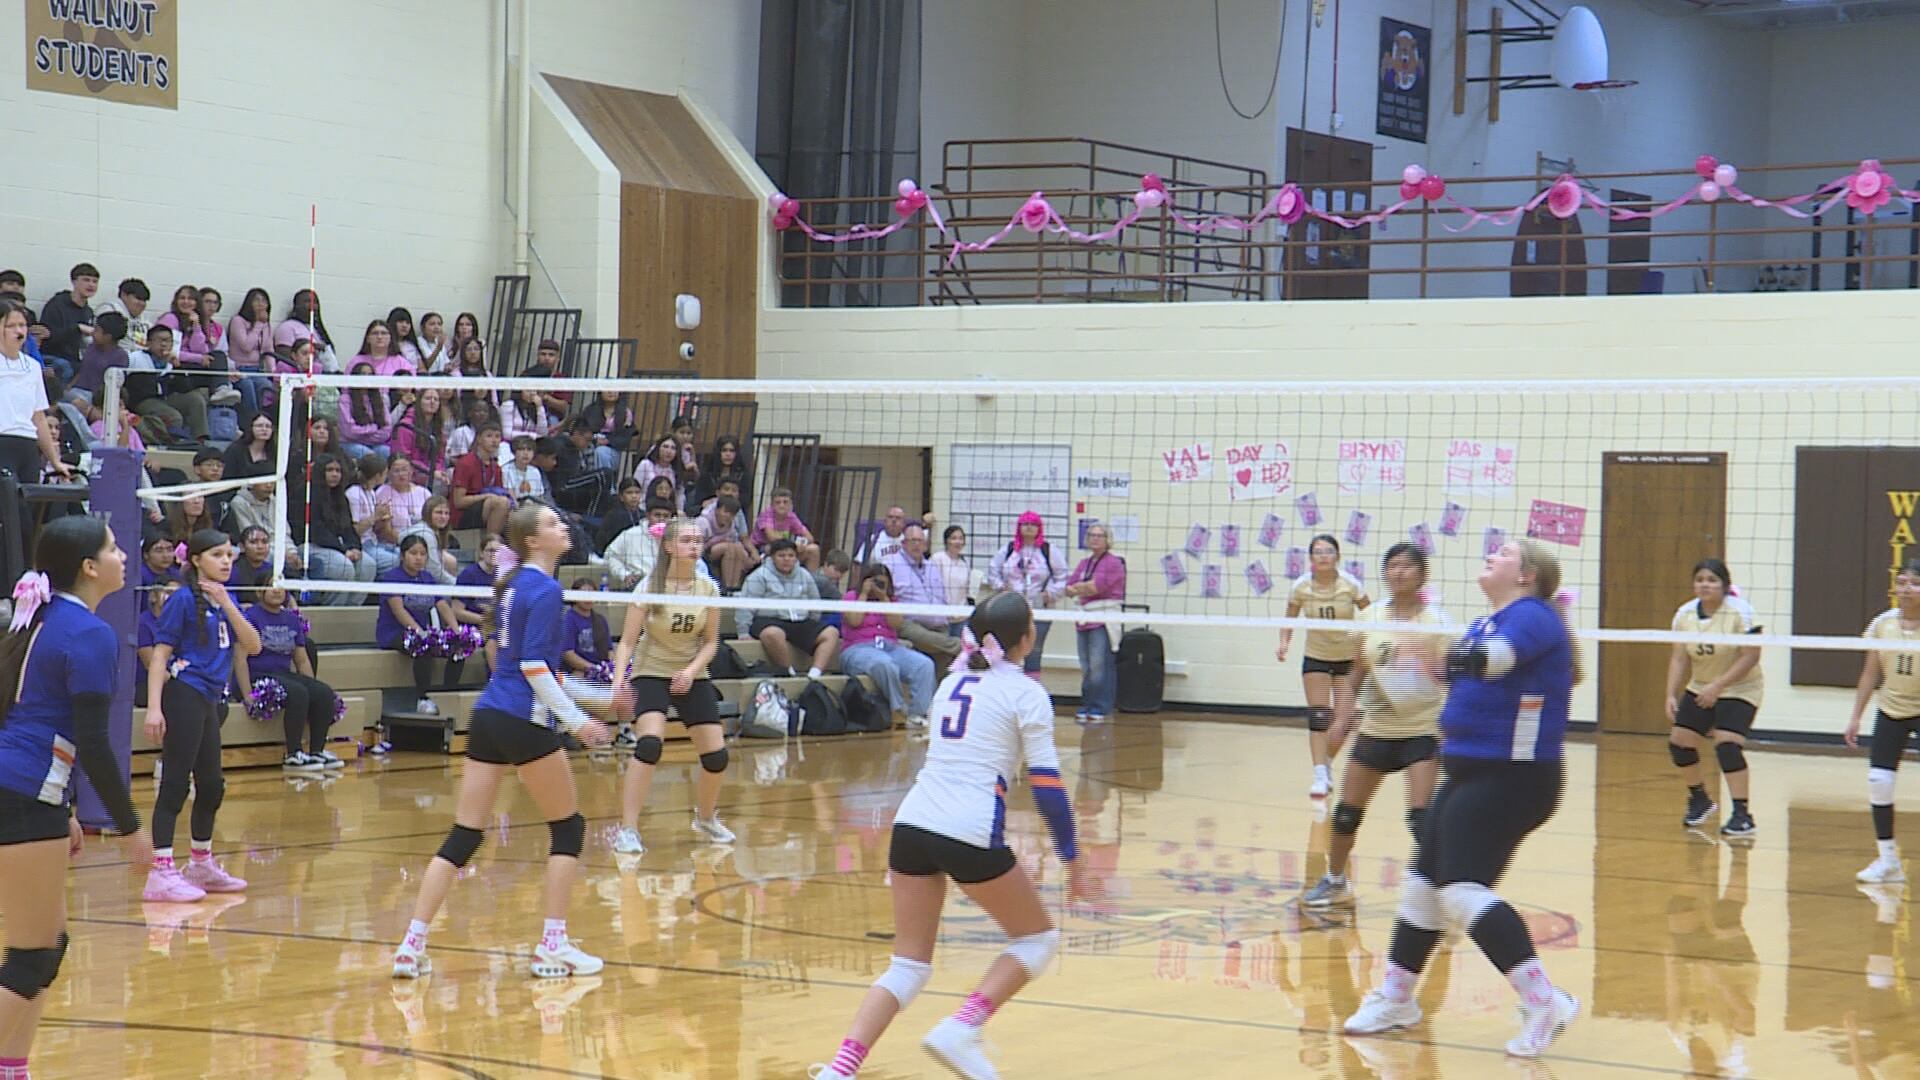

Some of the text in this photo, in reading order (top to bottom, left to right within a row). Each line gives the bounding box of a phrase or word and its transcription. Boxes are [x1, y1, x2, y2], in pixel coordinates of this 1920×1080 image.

[50, 0, 157, 35] WALNUT
[36, 38, 169, 89] STUDENTS
[1163, 444, 1210, 468] VAL
[1226, 444, 1262, 465] DAY
[1339, 442, 1395, 461] BRYN
[1447, 441, 1482, 458] JAS
[671, 612, 696, 634] 26
[1896, 654, 1913, 676] 11
[940, 674, 983, 740] 5
